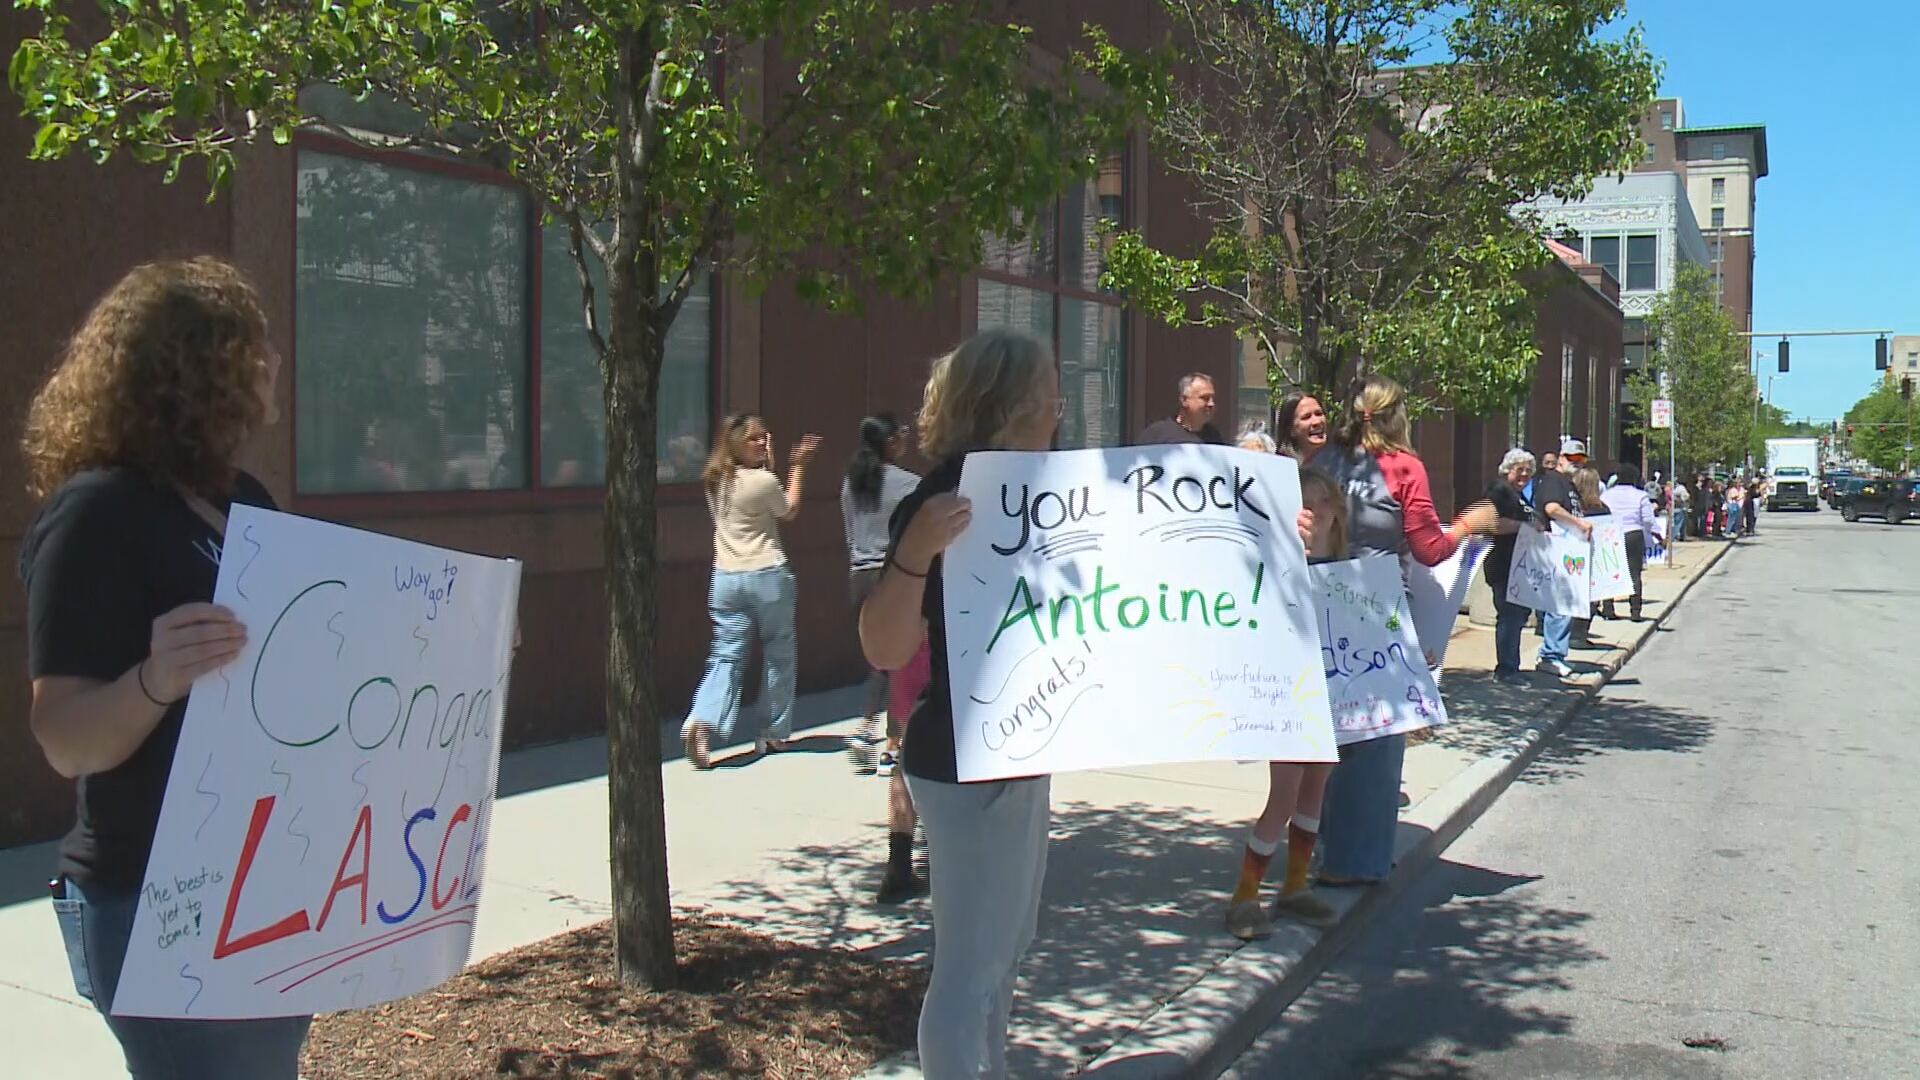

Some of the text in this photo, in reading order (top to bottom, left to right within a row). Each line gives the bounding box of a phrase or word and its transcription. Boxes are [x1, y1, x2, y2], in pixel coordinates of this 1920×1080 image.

[394, 559, 458, 596] Way to
[426, 577, 455, 621] go!
[986, 562, 1266, 654] Antoine!
[251, 579, 506, 806] Congra
[142, 866, 224, 909] The best is
[186, 898, 202, 912] to
[158, 911, 202, 949] come!
